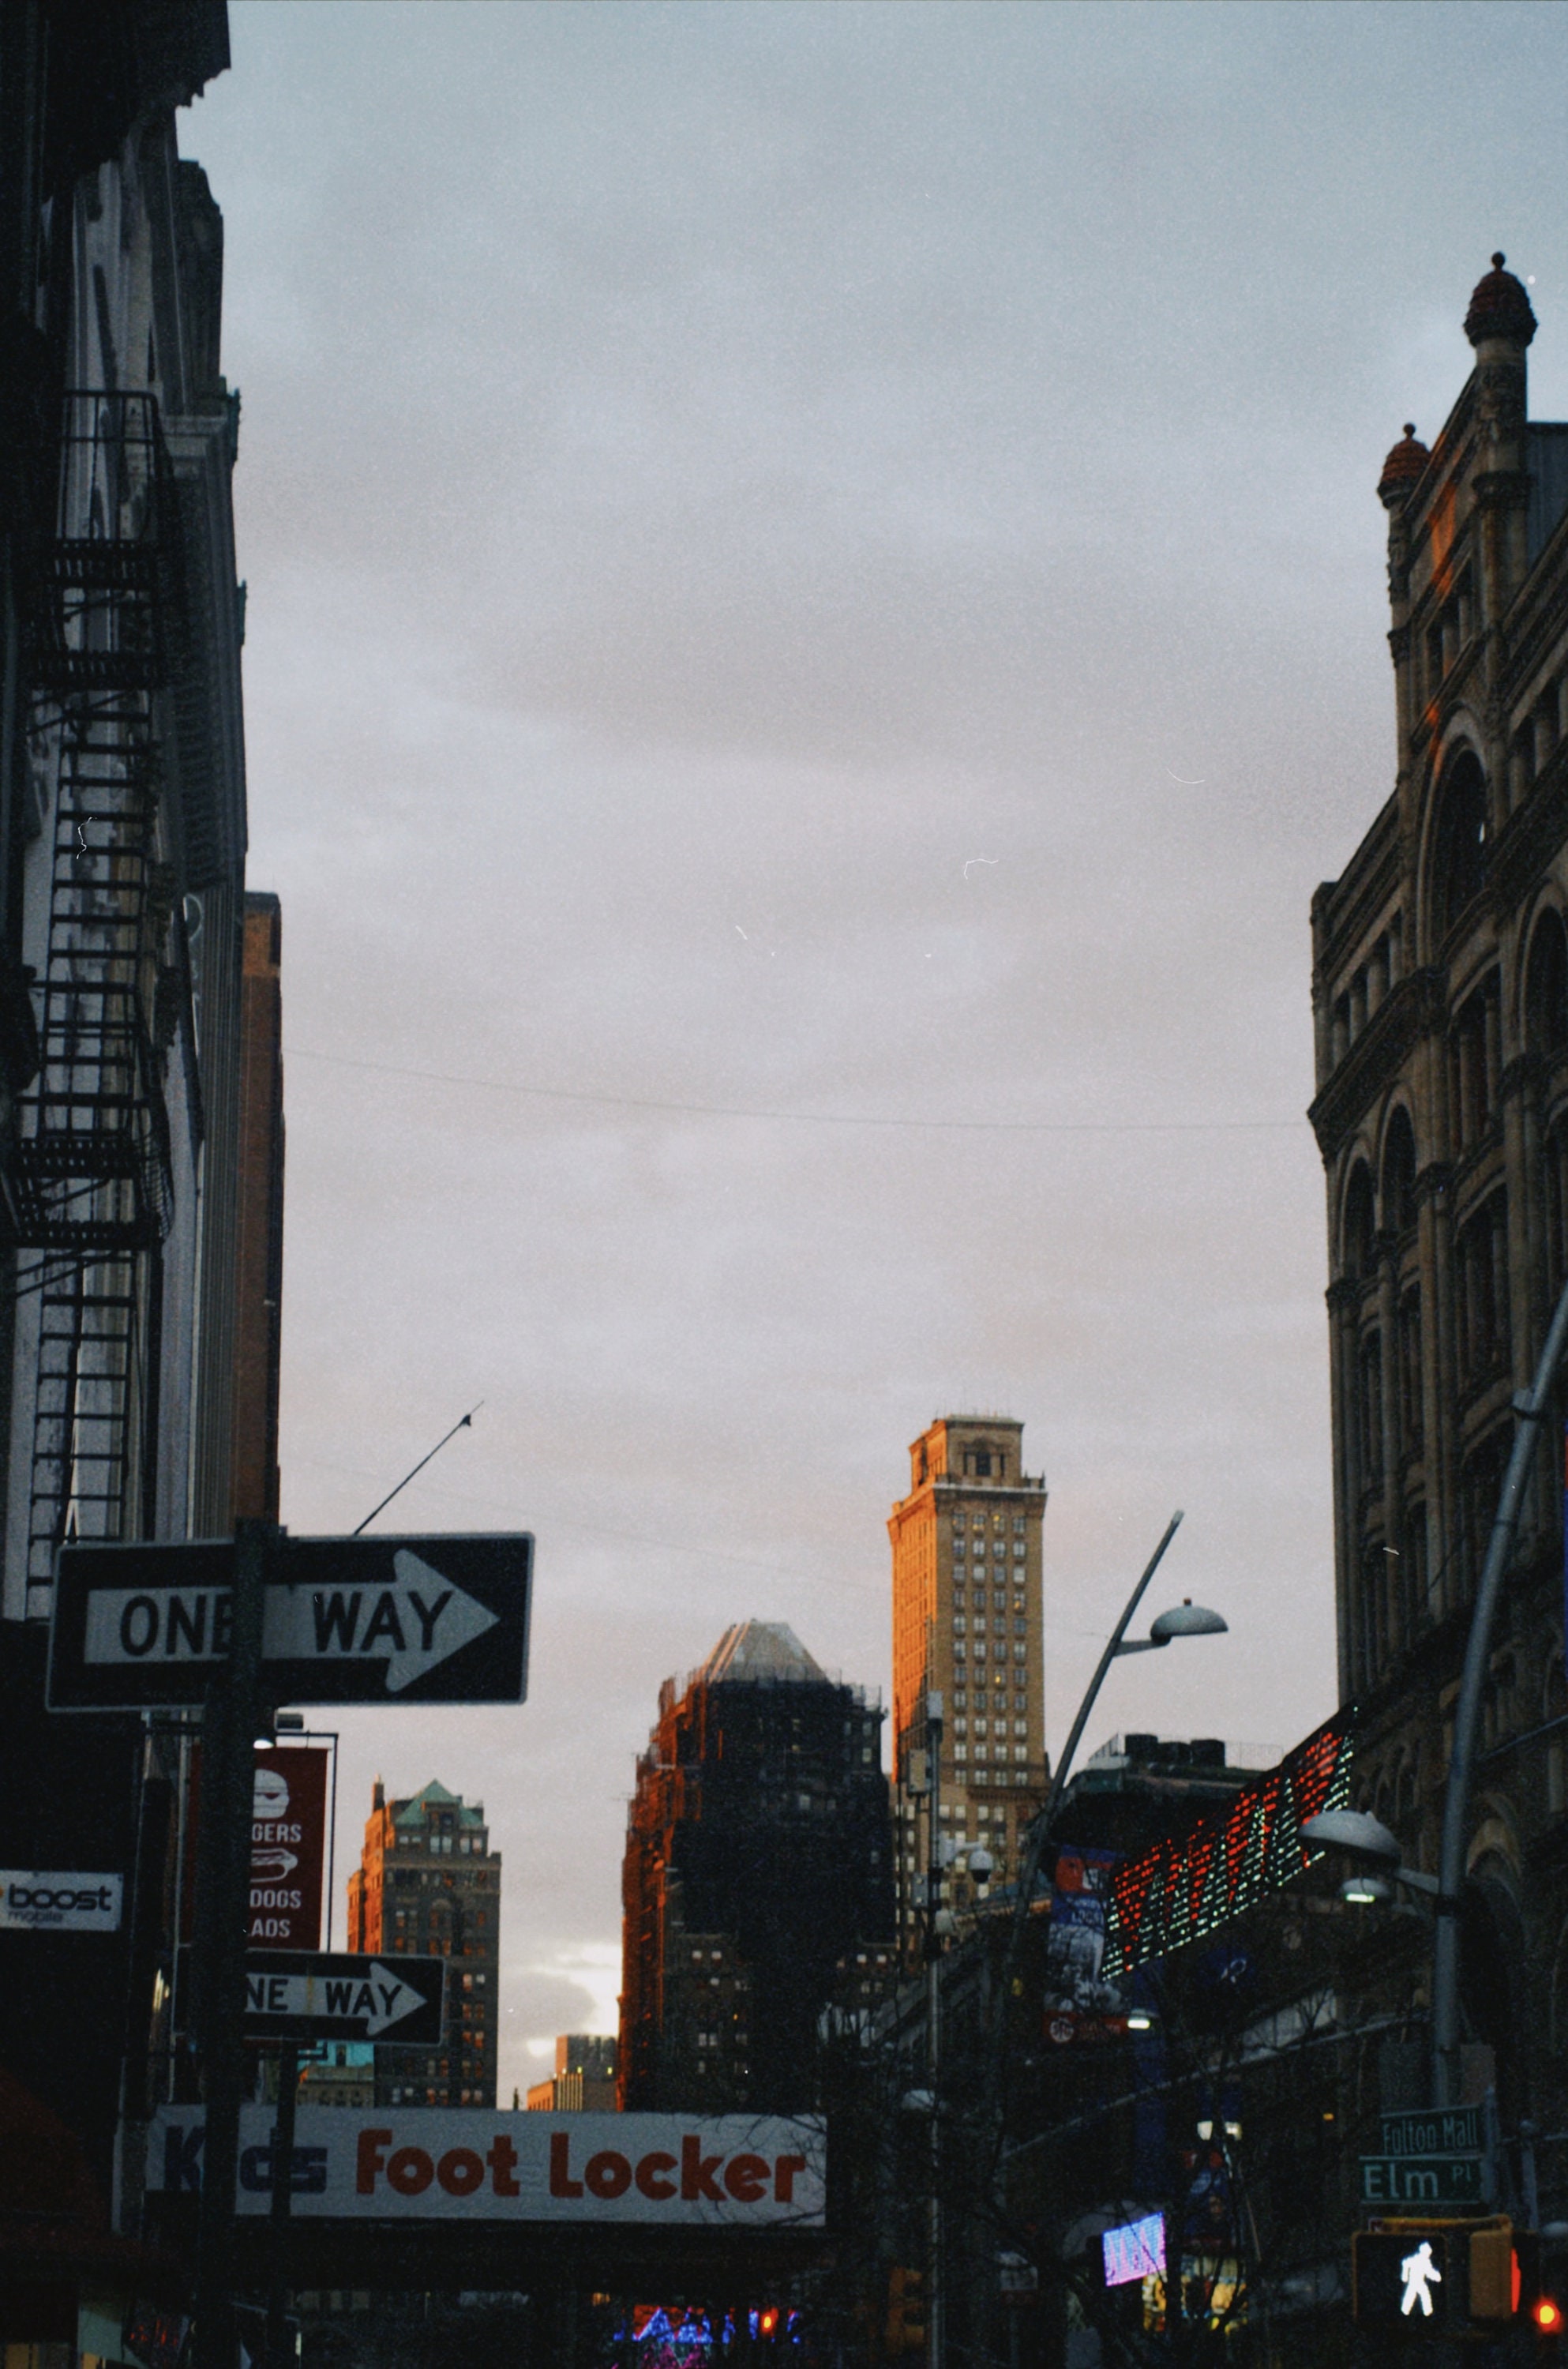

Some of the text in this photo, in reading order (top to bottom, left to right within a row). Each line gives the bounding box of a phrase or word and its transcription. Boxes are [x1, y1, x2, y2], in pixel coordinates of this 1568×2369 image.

[120, 1590, 453, 1656] ONE WAY
[250, 1823, 302, 1843] GERS
[9, 1883, 112, 1911] boost
[249, 1888, 302, 1909] DOGS
[251, 1917, 291, 1938] ADS
[245, 1977, 403, 2016] NE WAY
[1382, 2110, 1478, 2155] Fulton Mall
[164, 2125, 806, 2202] Kds Foot Locker
[1364, 2162, 1472, 2198] Elm Pl
